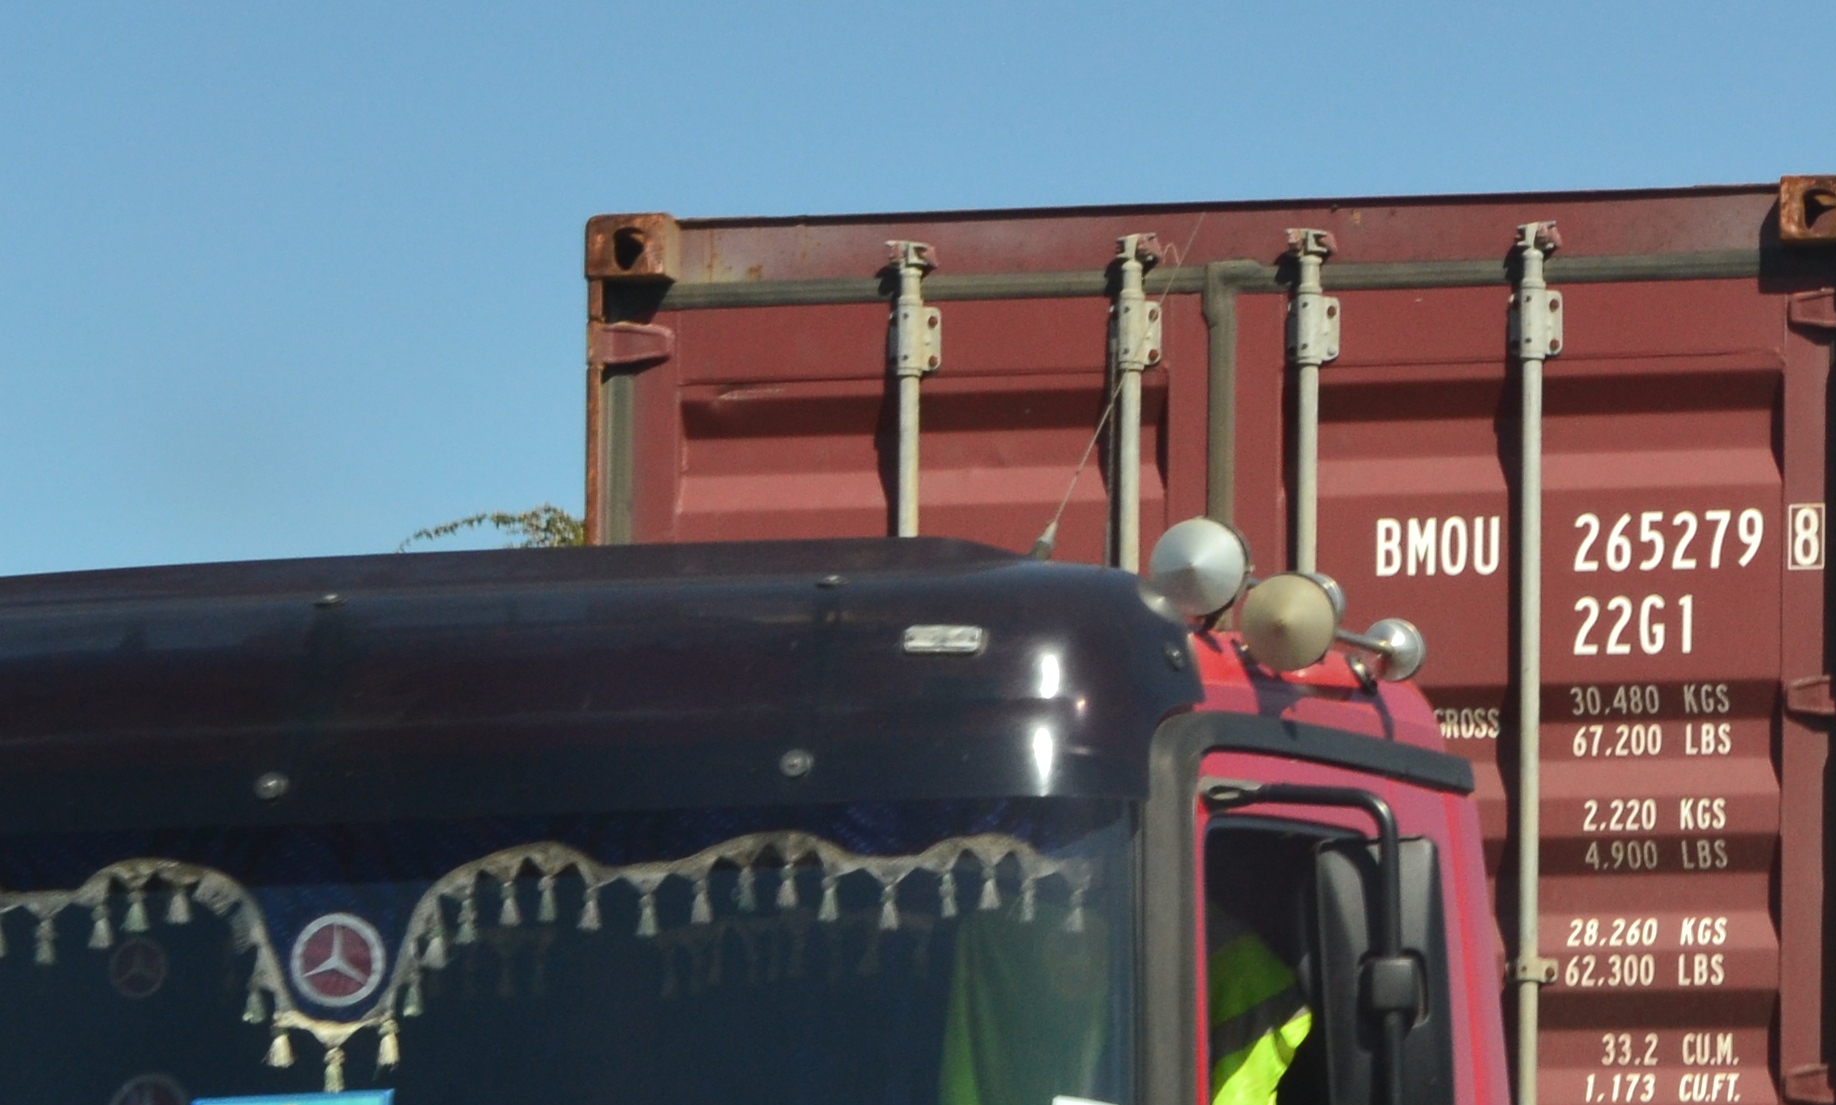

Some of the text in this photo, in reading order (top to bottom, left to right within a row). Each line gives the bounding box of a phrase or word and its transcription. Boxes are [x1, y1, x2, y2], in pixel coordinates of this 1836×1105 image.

[1375, 506, 1819, 577] BMOU 265279 8
[1573, 594, 1693, 655] 22G1
[1683, 683, 1731, 714] KGS
[1685, 722, 1732, 756] LBS
[1680, 797, 1726, 830] KGS
[1681, 839, 1729, 869] LBS
[1680, 916, 1727, 946] KGS
[1678, 953, 1725, 986] LBS
[1602, 1032, 1739, 1066] 33.2 CU.M.
